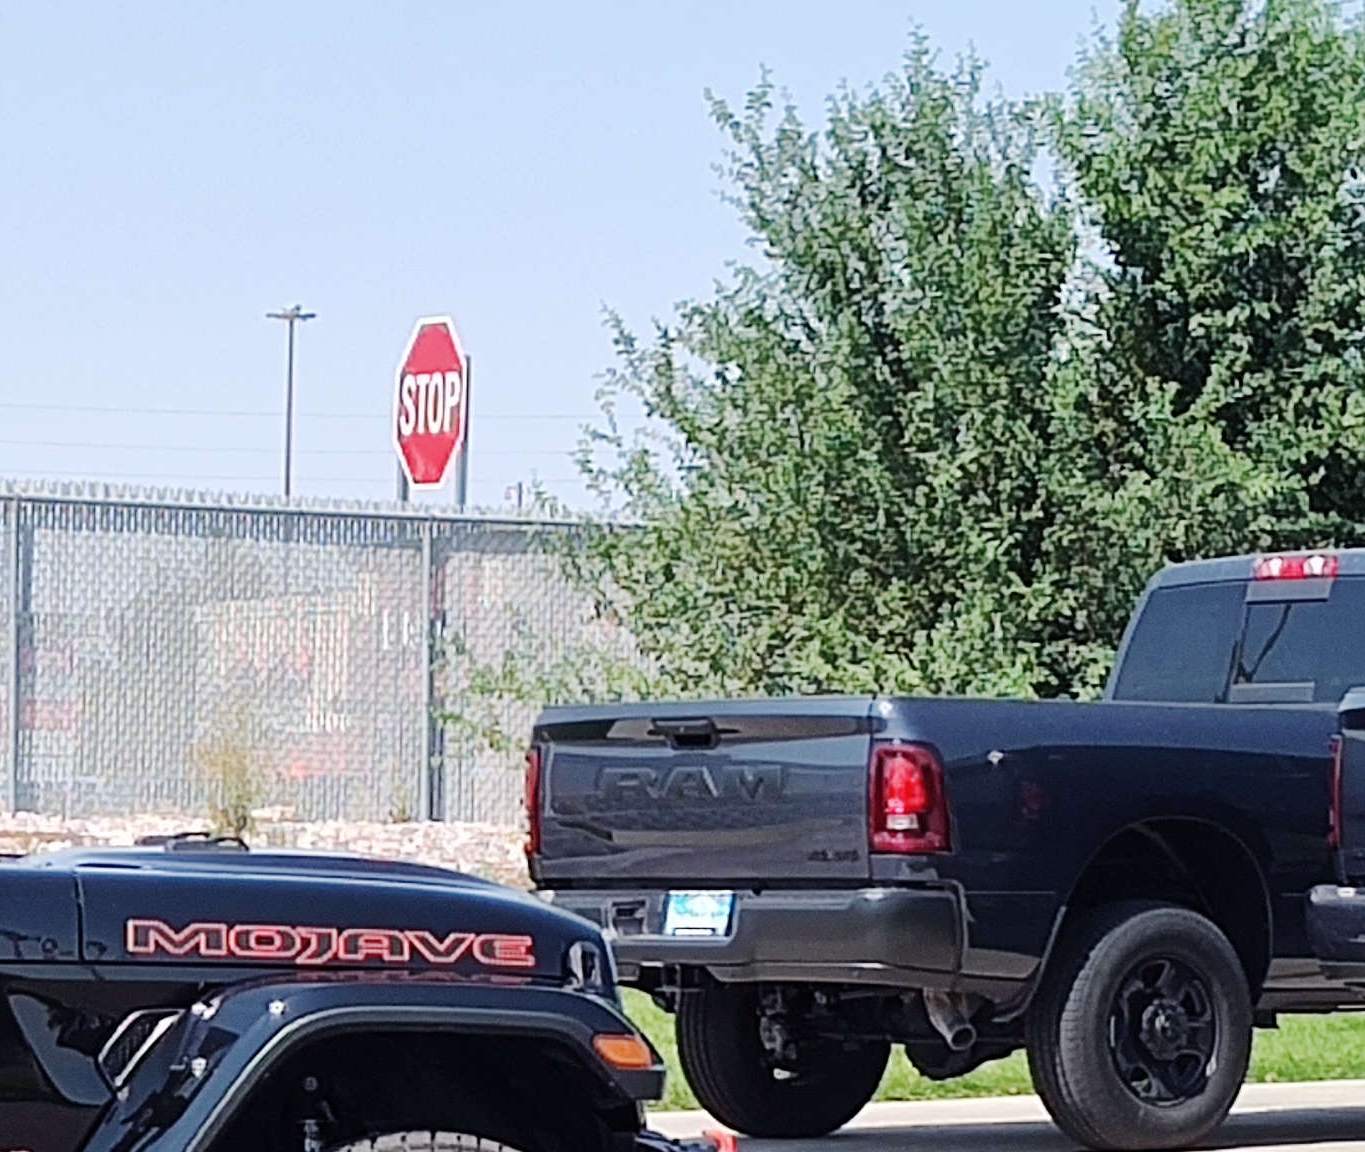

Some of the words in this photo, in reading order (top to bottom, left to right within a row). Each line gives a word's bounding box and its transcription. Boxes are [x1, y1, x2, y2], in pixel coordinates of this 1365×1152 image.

[399, 371, 461, 436] STOP
[600, 766, 783, 801] RAM
[126, 919, 537, 967] MOJAVE
